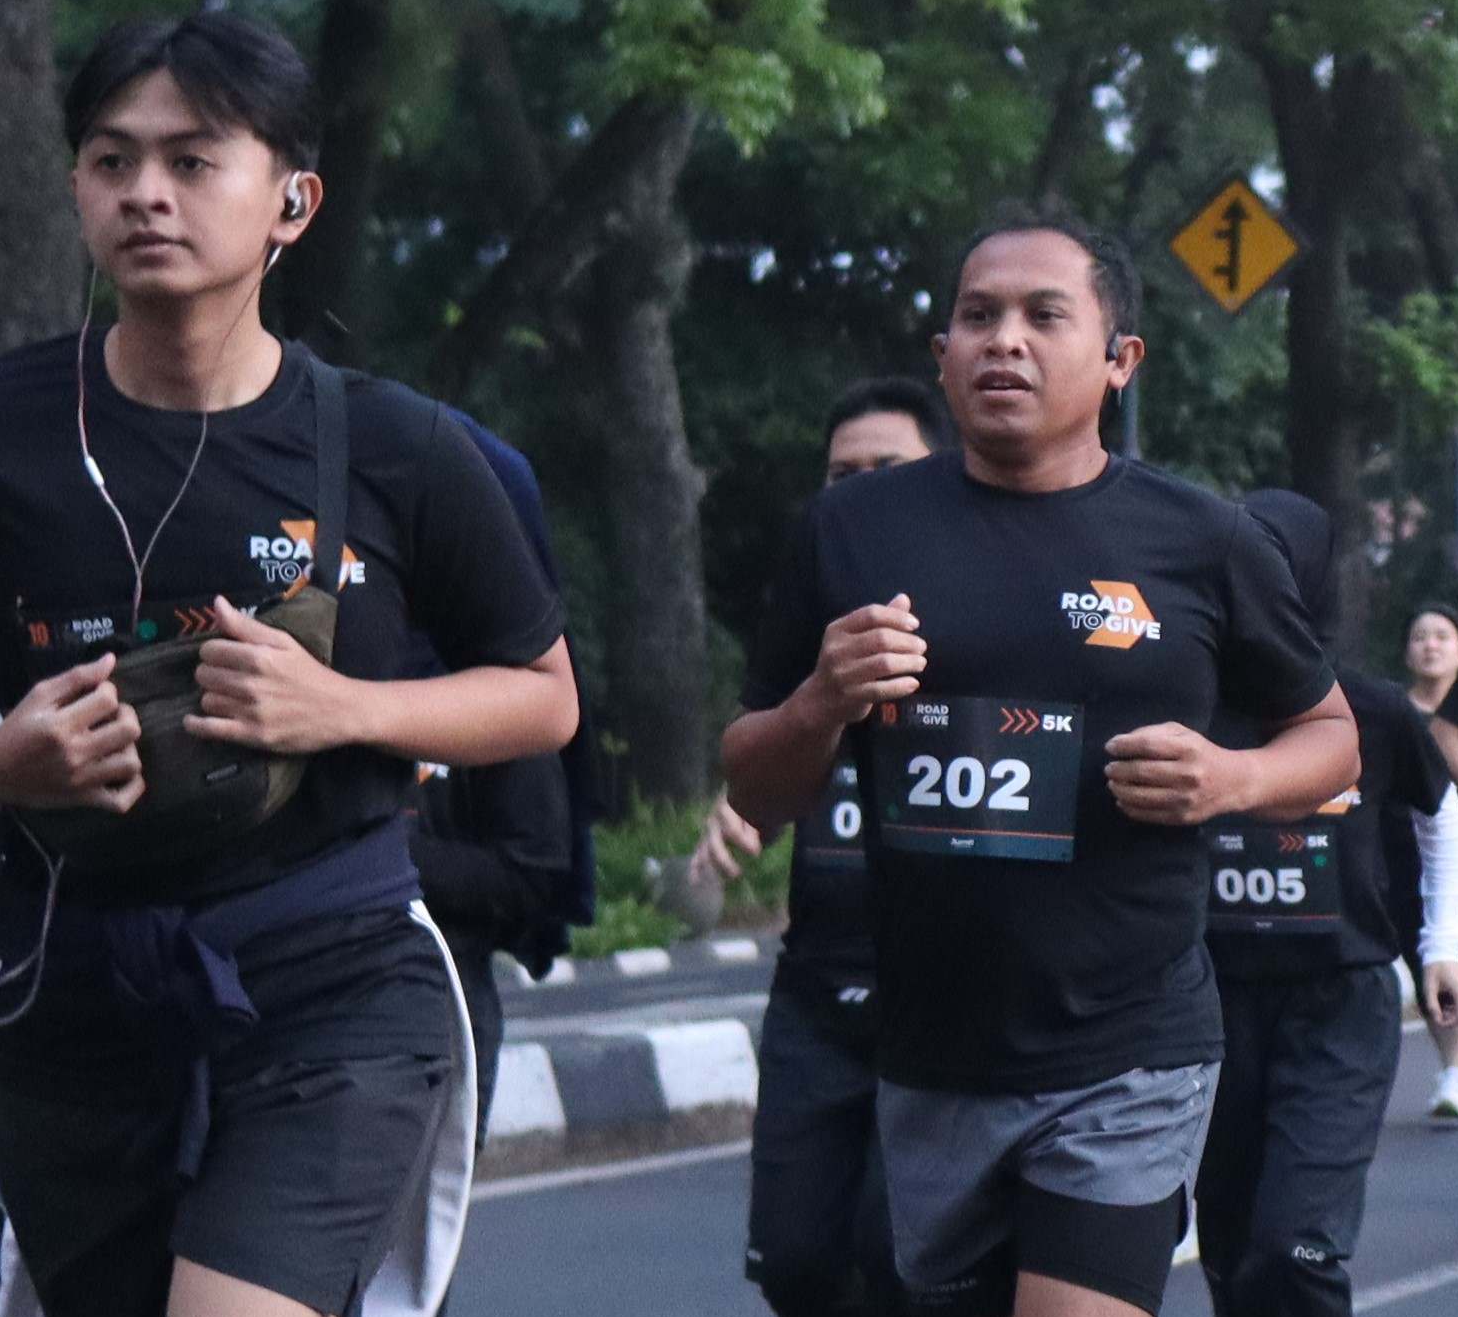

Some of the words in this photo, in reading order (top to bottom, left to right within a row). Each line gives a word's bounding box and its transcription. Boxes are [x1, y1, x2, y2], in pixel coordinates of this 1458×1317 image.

[249, 535, 314, 560] ROA
[1061, 592, 1135, 615] ROAD
[1068, 611, 1103, 630] TO
[1105, 613, 1162, 640] GIVE
[916, 703, 949, 716] ROAD
[922, 714, 949, 726] GIVE
[1042, 713, 1074, 733] 5K
[907, 754, 1032, 812] 202
[1306, 834, 1329, 848] 5K
[1215, 866, 1307, 905] 005
